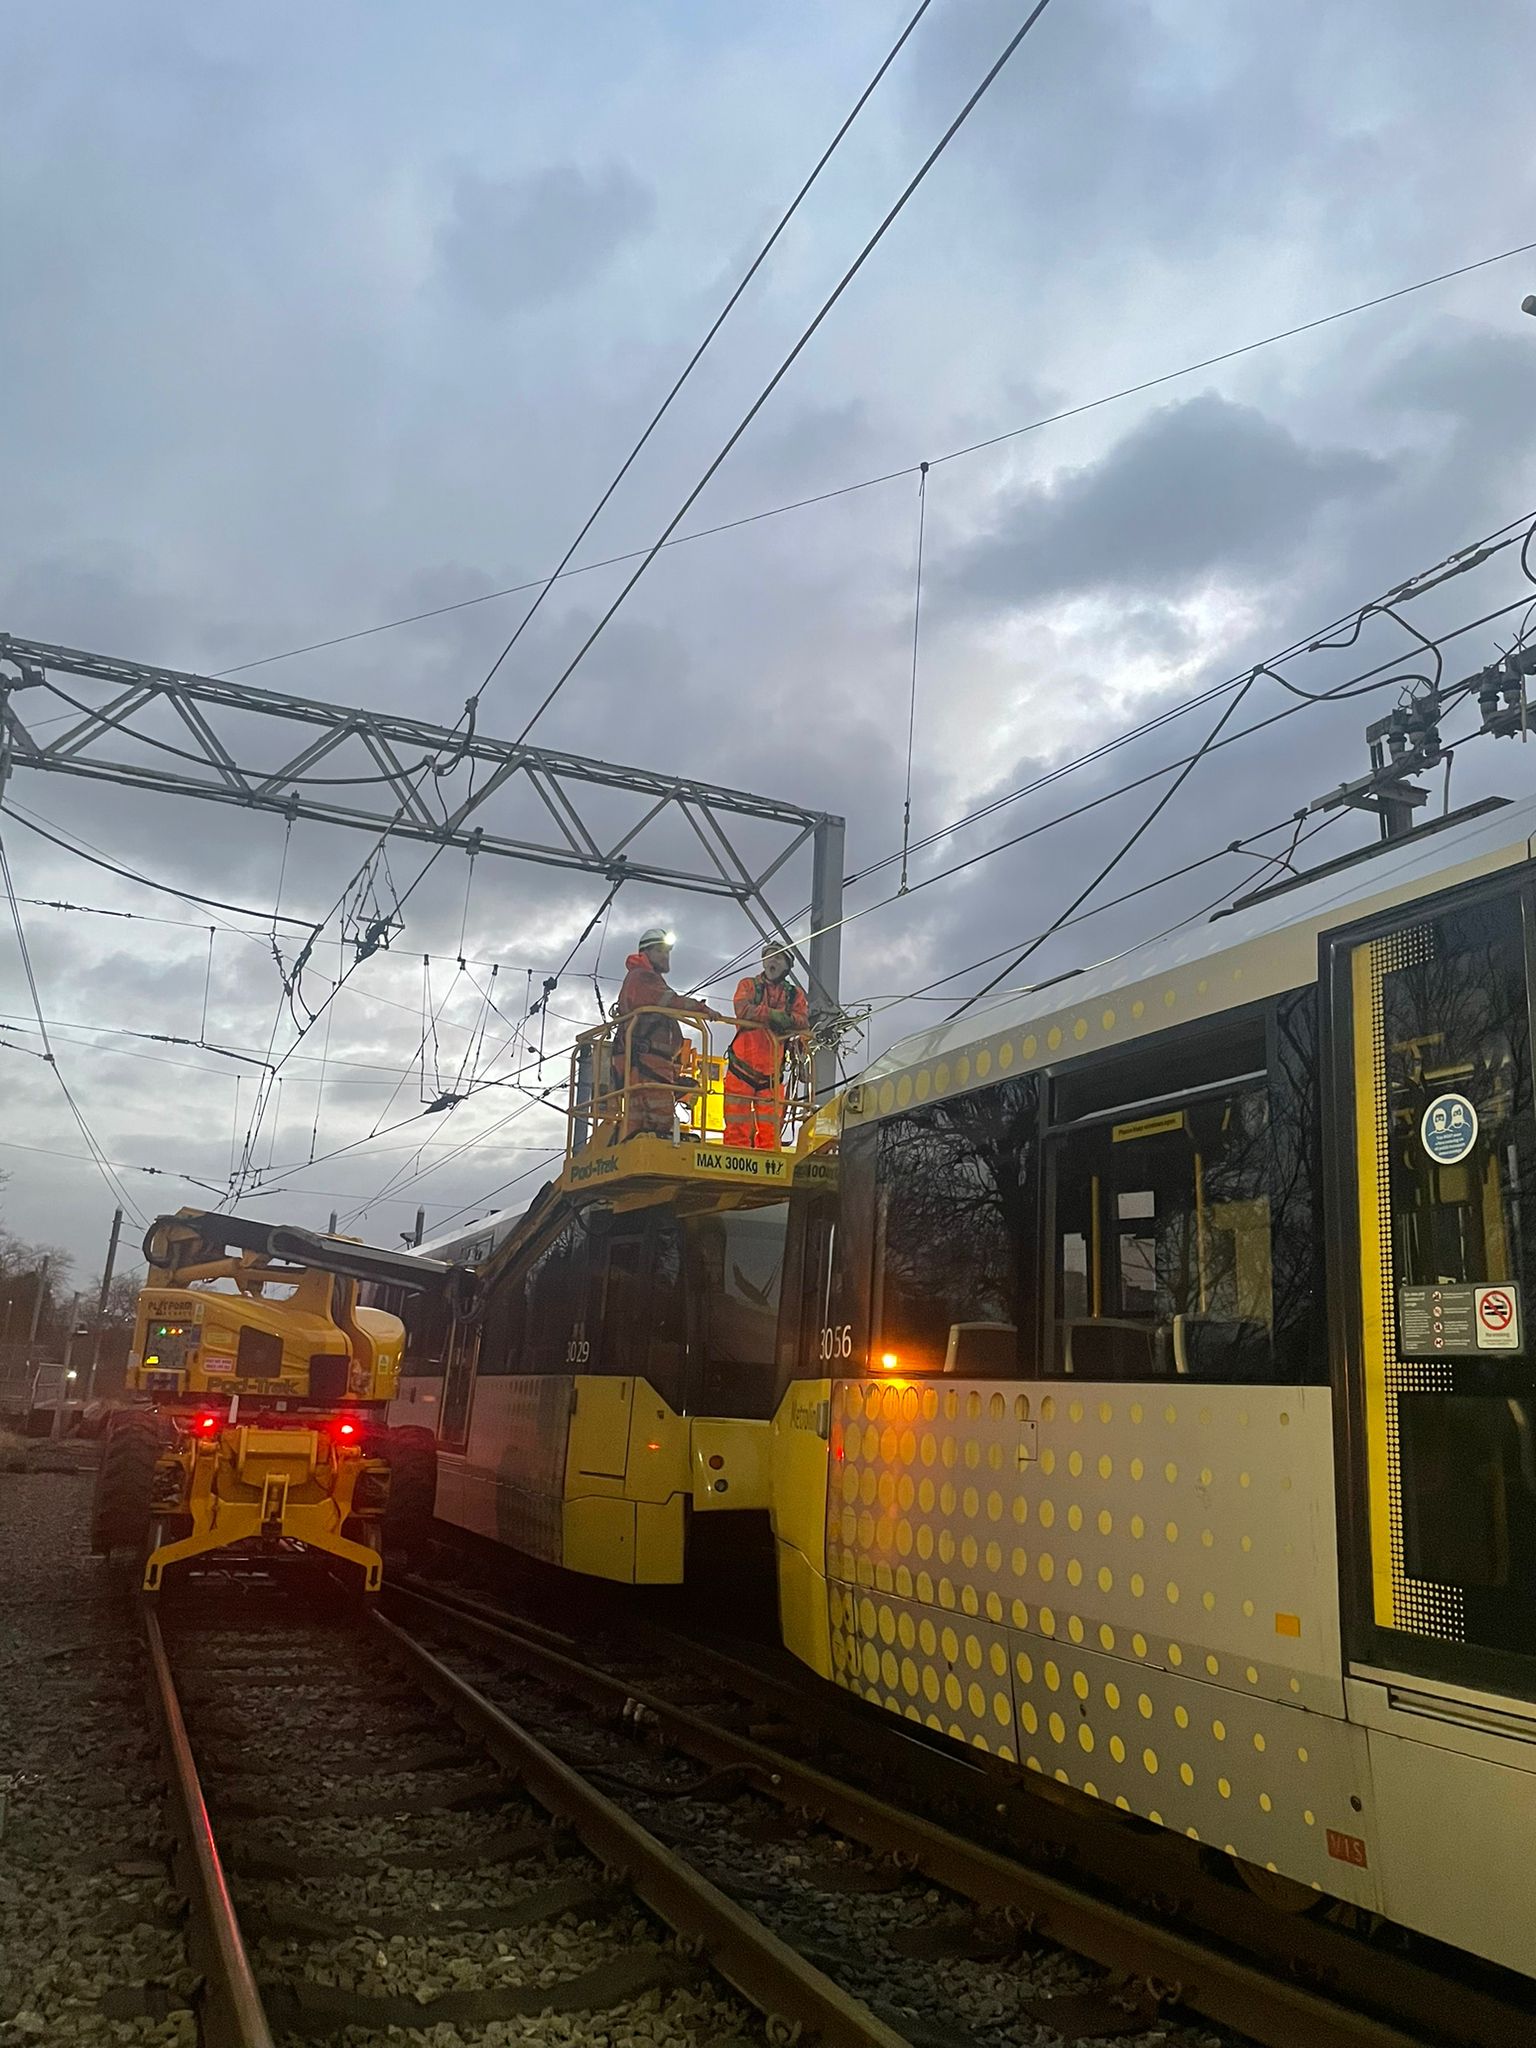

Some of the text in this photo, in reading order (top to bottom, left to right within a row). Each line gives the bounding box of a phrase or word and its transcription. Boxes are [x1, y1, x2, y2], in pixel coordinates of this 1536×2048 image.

[570, 1155, 619, 1183] Pod-Trak
[697, 1153, 758, 1174] MAX 300Kg
[819, 1324, 852, 1360] 3056
